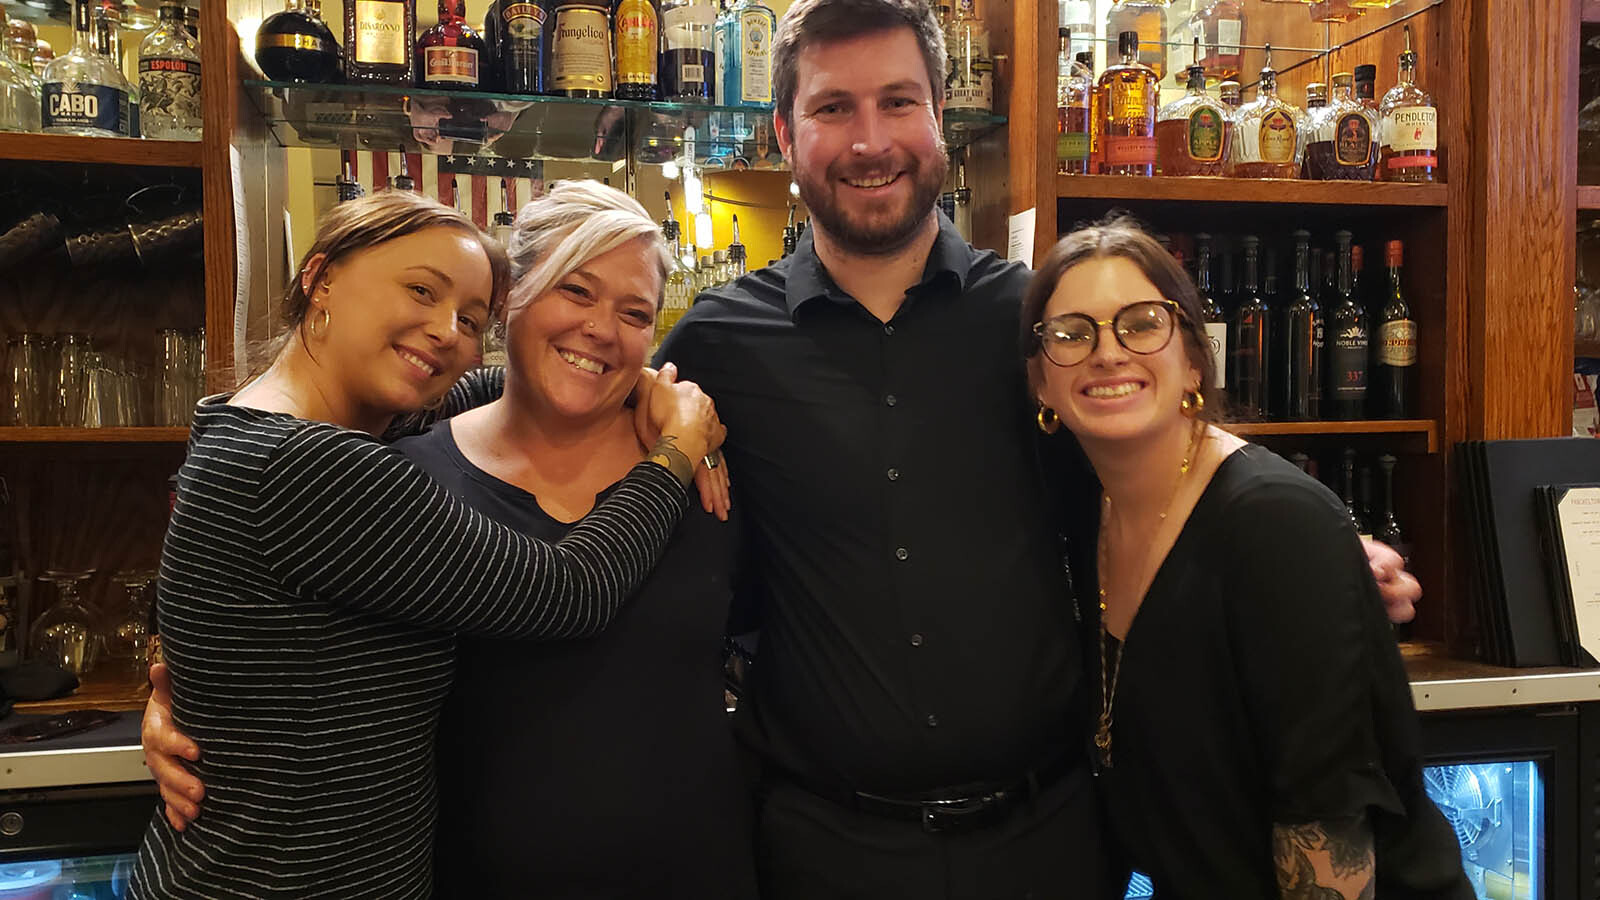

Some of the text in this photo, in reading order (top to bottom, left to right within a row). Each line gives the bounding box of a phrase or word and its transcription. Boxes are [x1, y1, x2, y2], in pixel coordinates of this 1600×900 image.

[359, 21, 401, 33] DISARONNO
[556, 22, 604, 42] Frangelico
[50, 93, 98, 118] CABO
